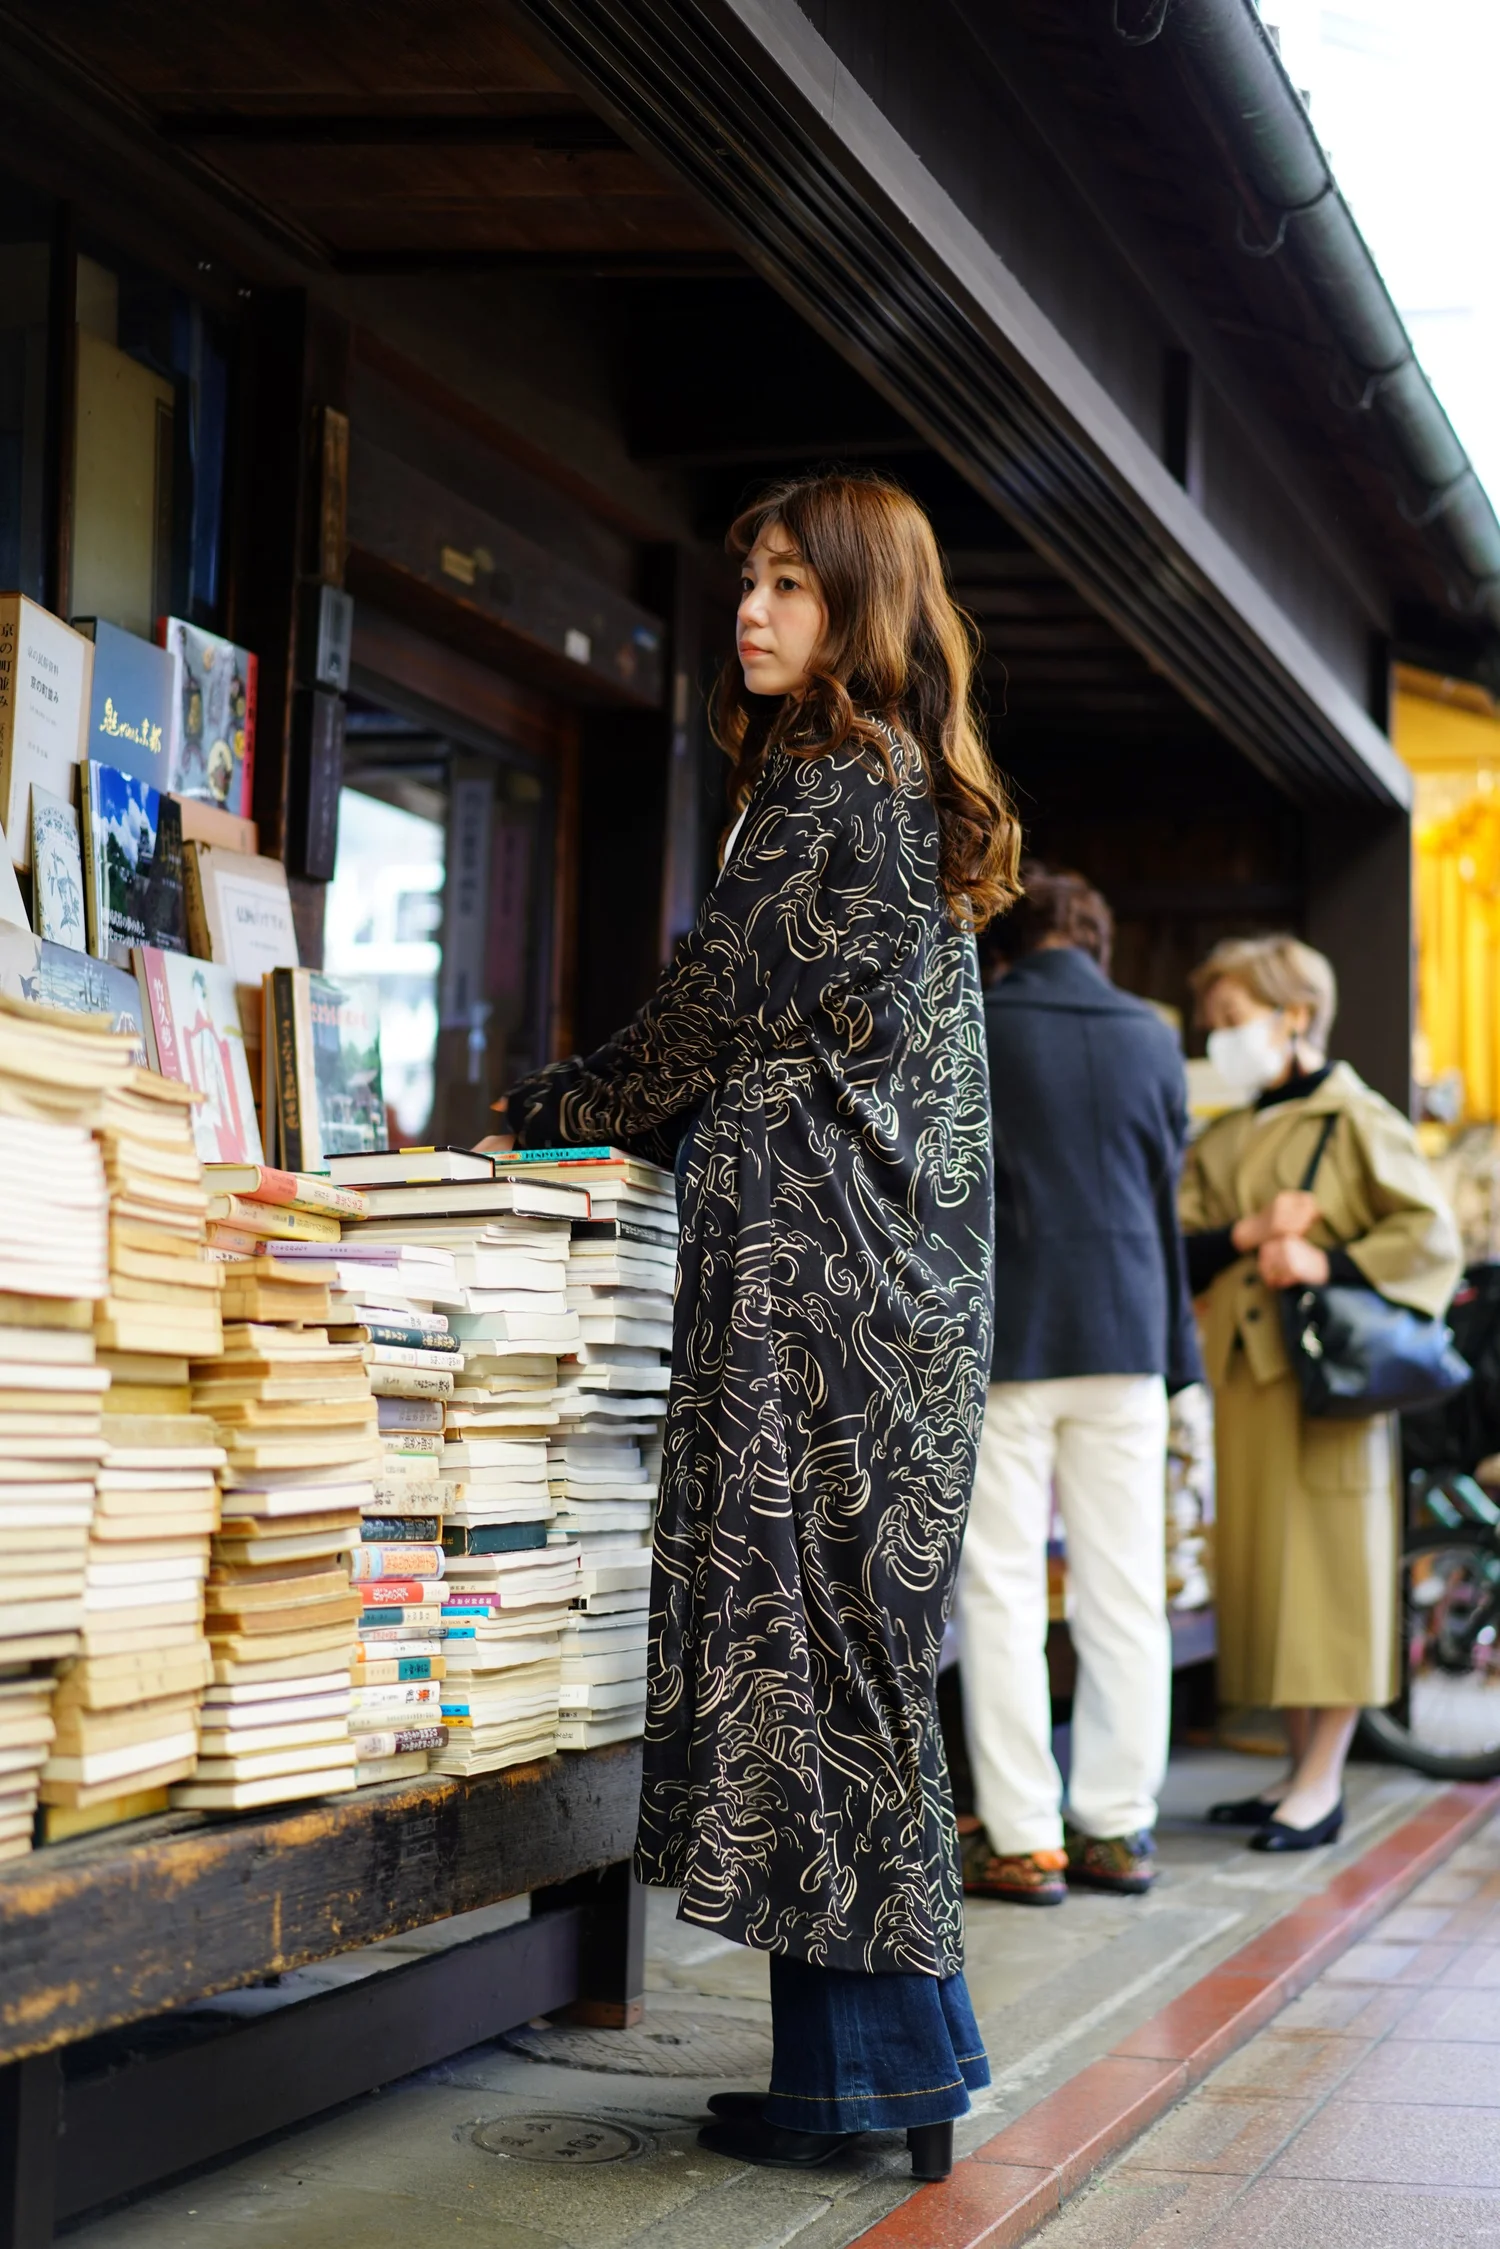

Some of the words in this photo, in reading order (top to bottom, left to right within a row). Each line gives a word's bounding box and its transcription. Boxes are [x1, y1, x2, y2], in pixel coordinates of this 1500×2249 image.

[30, 675, 60, 705] 京の町並み
